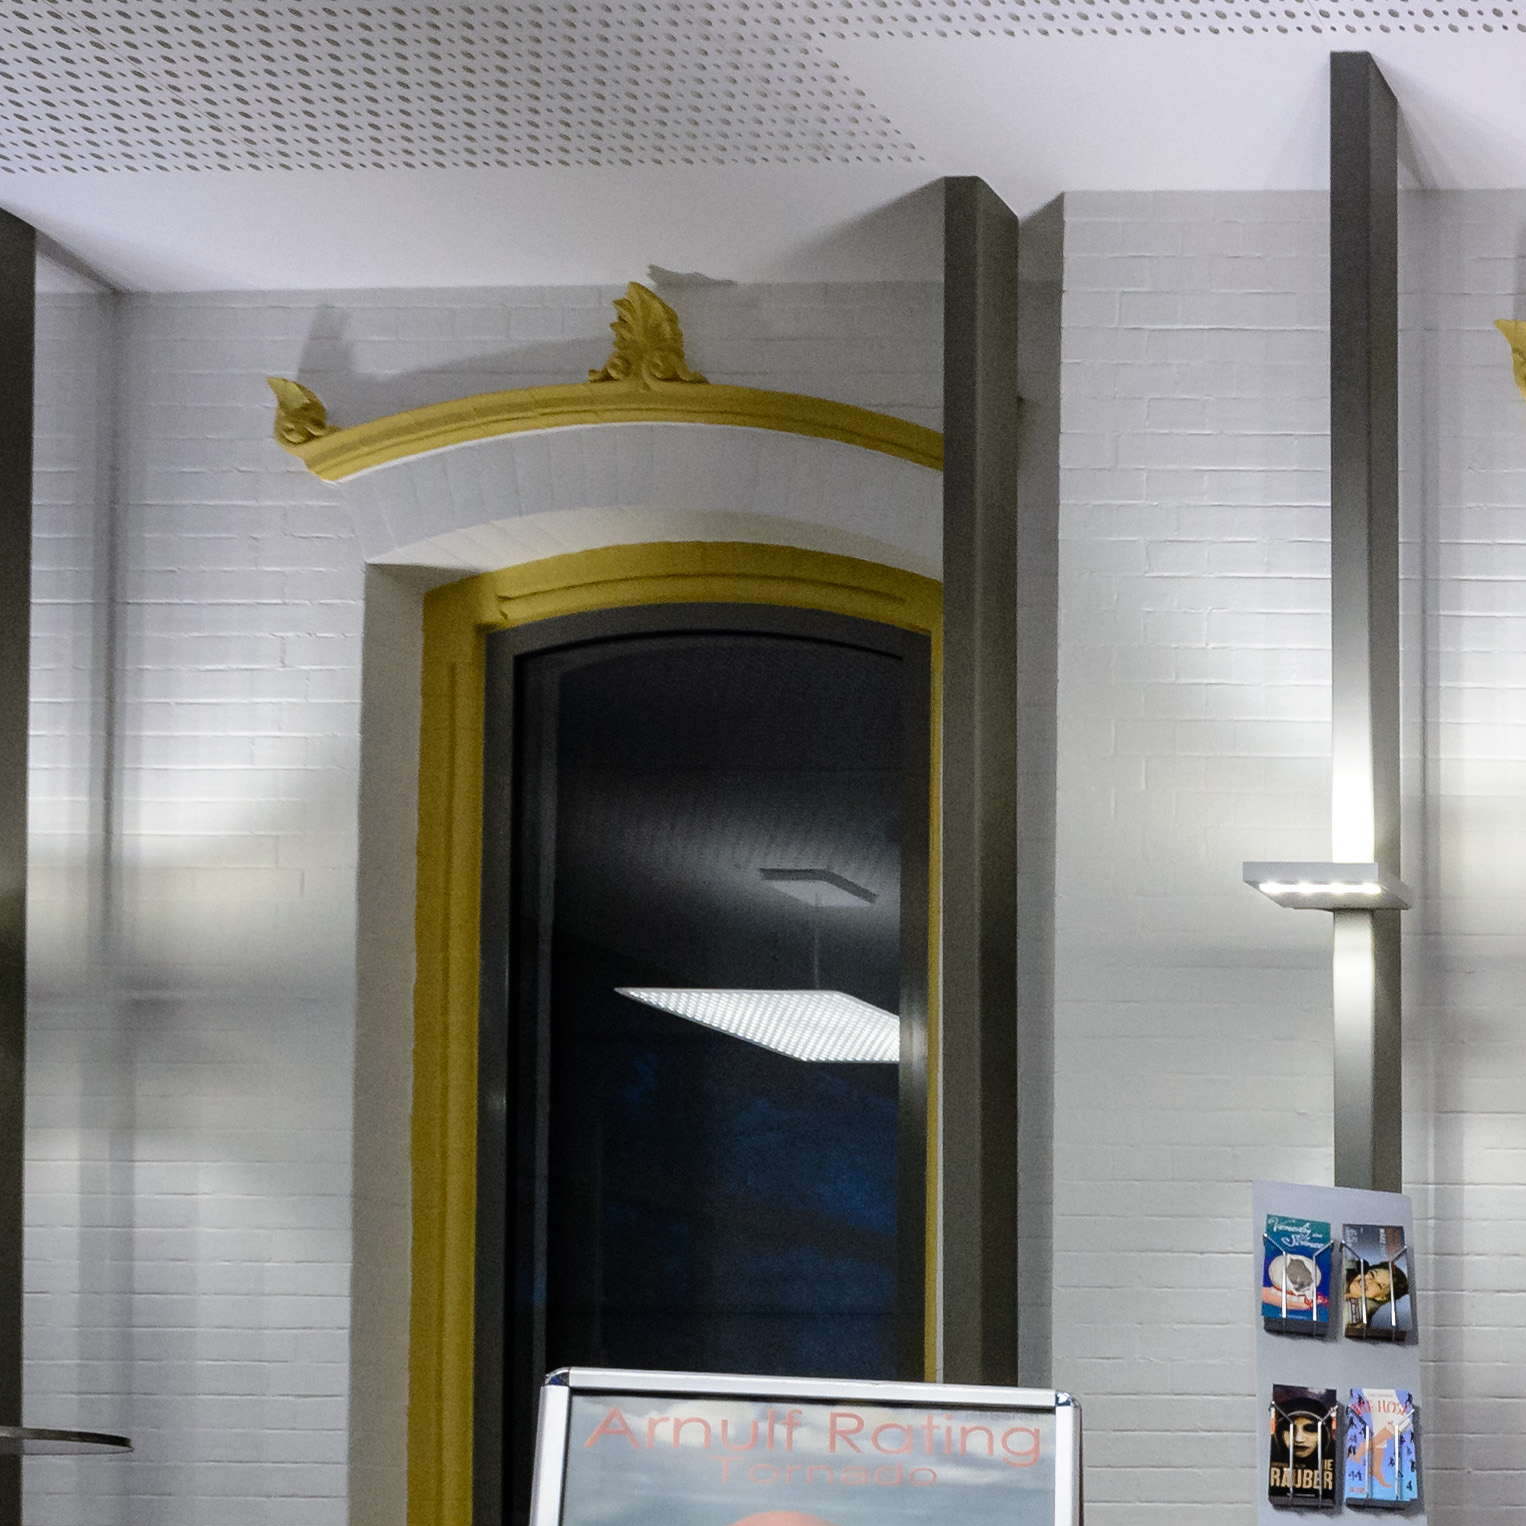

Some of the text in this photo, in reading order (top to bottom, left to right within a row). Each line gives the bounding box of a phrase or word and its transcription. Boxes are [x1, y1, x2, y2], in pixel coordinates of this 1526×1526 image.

[584, 1406, 1041, 1468] Arnulf Rating
[708, 1455, 938, 1487] Tornado
